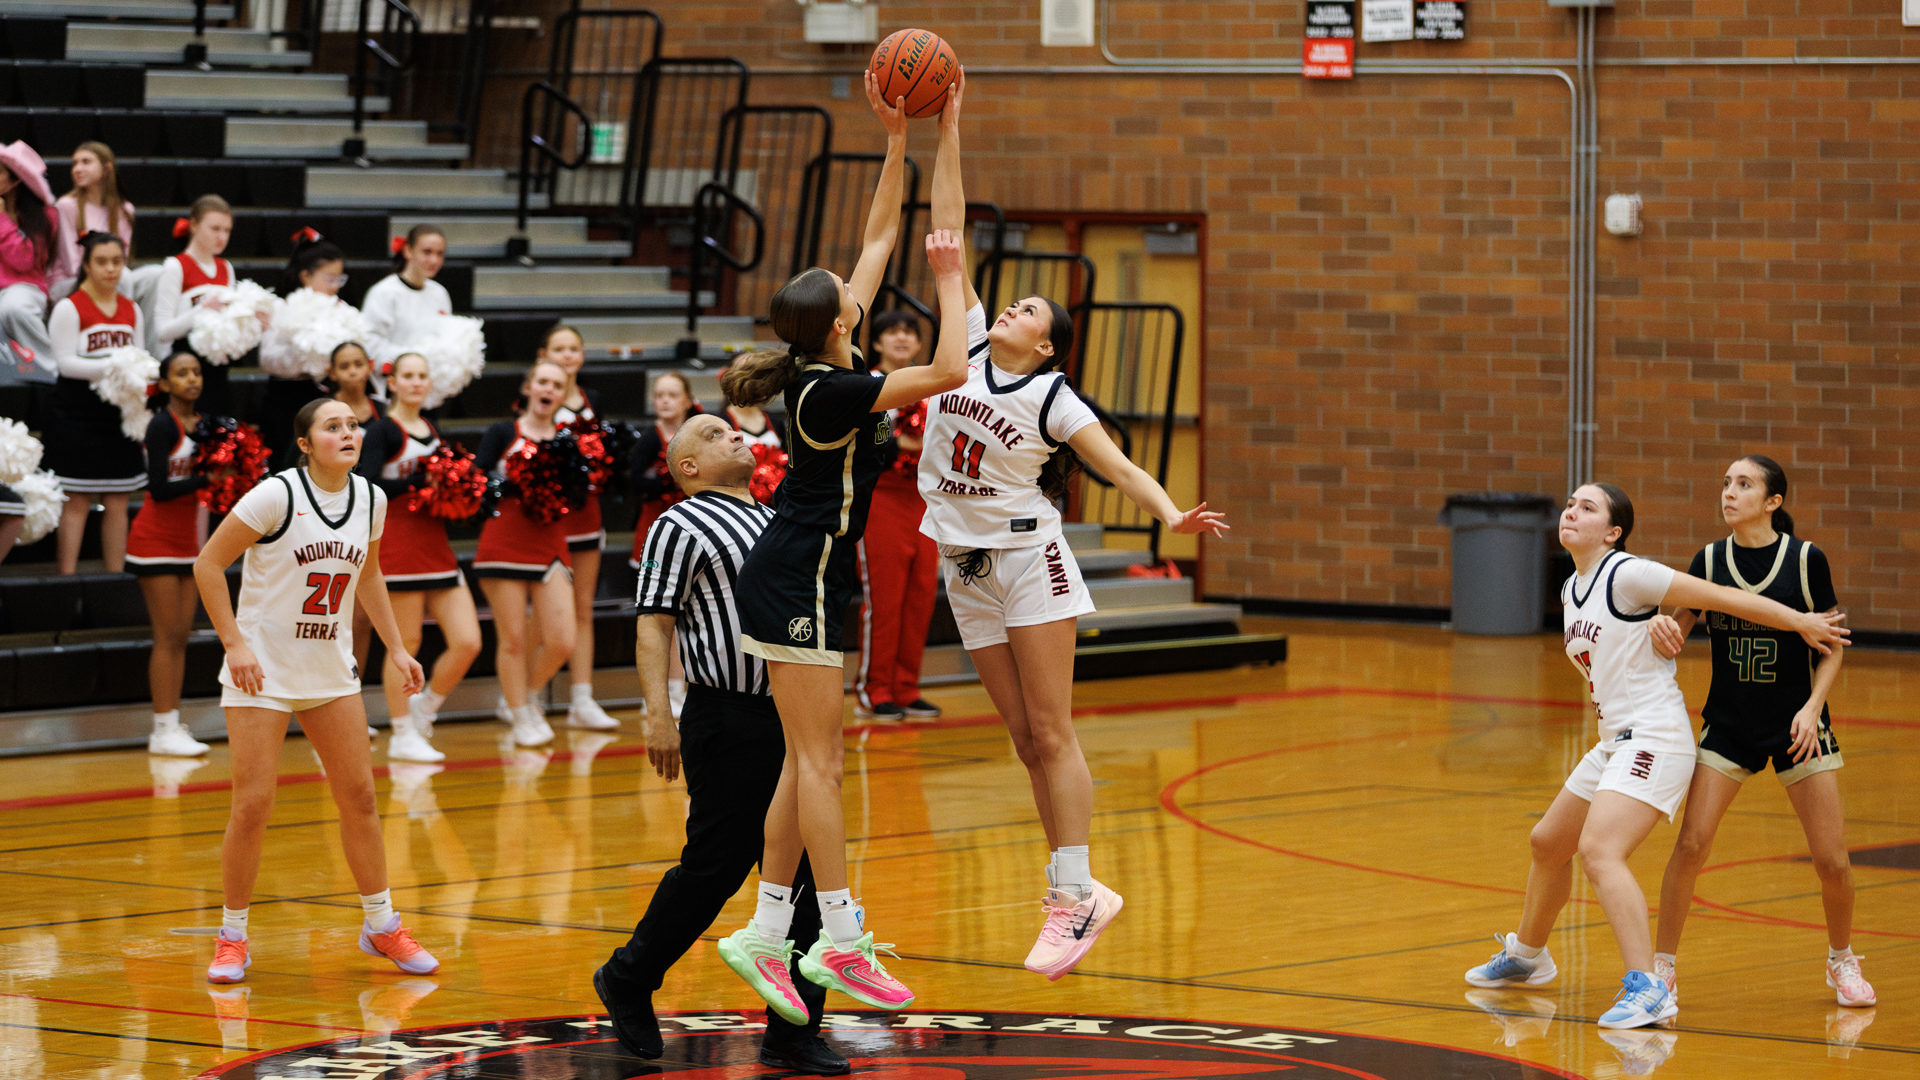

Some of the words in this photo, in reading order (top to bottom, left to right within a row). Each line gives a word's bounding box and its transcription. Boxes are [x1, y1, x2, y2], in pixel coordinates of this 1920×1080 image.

[939, 393, 1024, 451] MOUNTLAKE
[951, 430, 986, 480] 11
[302, 571, 352, 616] 20
[1046, 541, 1070, 597] HAWKS
[1728, 636, 1778, 683] 42
